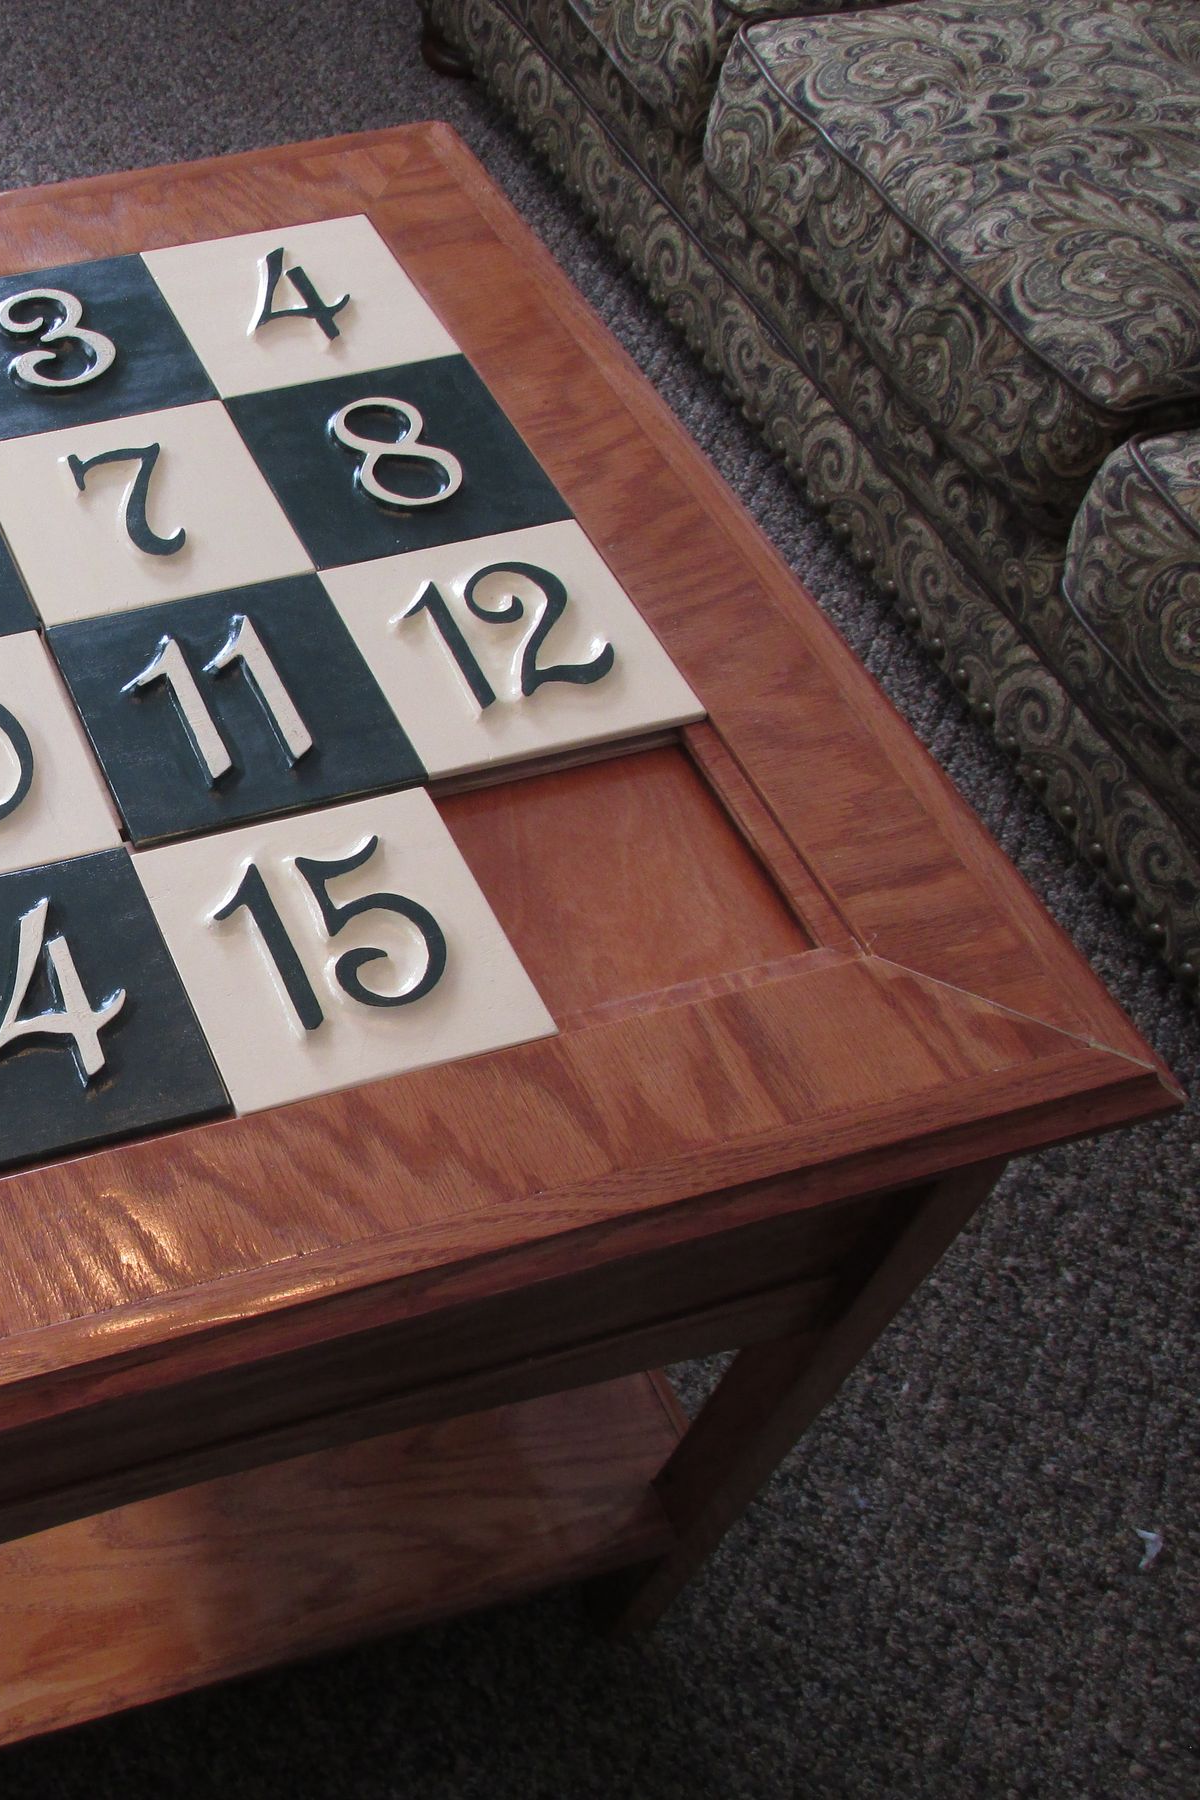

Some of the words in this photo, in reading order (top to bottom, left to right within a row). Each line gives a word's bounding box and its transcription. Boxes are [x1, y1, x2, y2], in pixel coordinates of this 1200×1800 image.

[252, 248, 351, 343] 4
[67, 442, 187, 558] 7
[326, 397, 464, 507] 8
[122, 615, 314, 781] 11
[398, 560, 613, 713] 12
[212, 834, 445, 1032] 15
